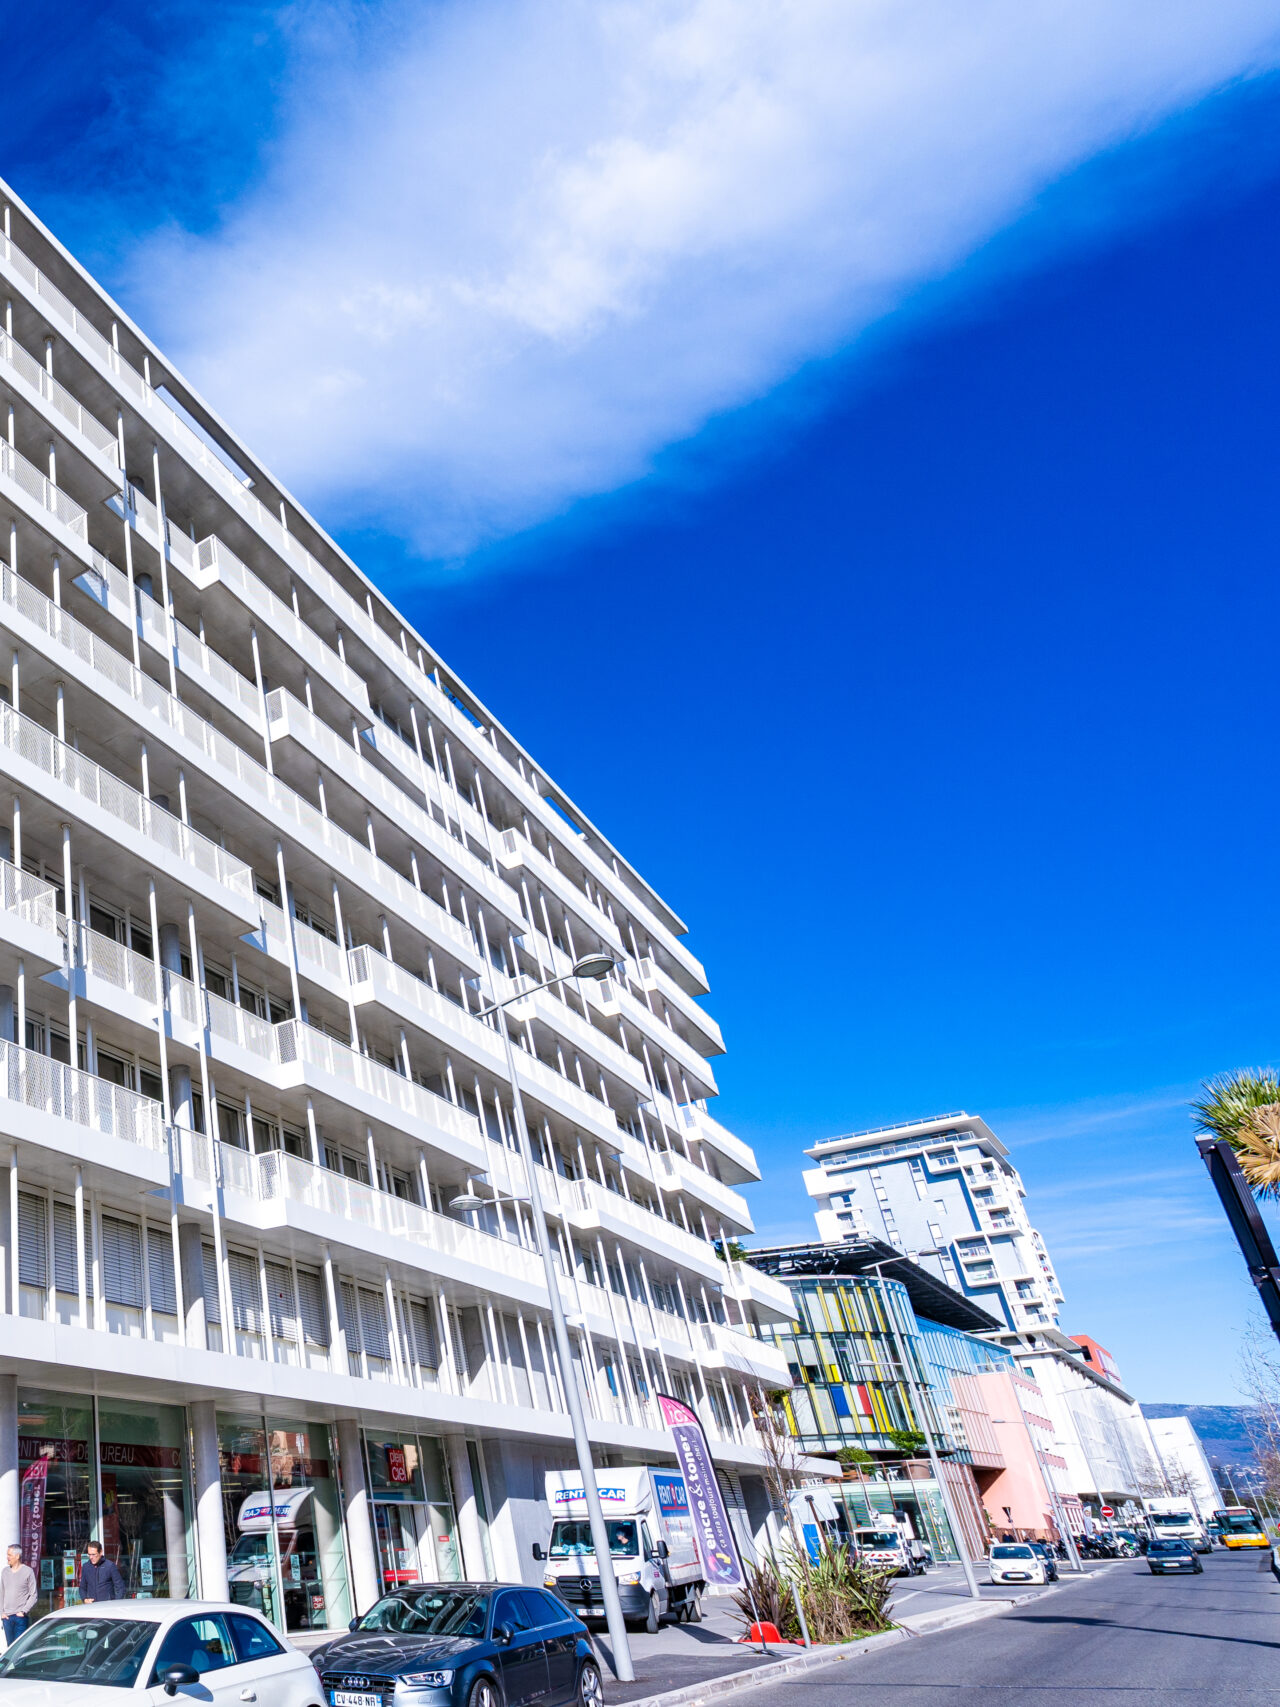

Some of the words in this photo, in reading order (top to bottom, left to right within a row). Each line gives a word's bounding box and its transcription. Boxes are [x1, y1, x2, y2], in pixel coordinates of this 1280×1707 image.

[679, 1434, 699, 1482] toner
[555, 1489, 586, 1501] RENT
[599, 1488, 625, 1499] CAR
[658, 1484, 672, 1504] RENT
[675, 1485, 687, 1504] CAR
[688, 1483, 703, 1498] &
[697, 1500, 717, 1550] encre
[927, 1489, 952, 1554] PREMIUM
